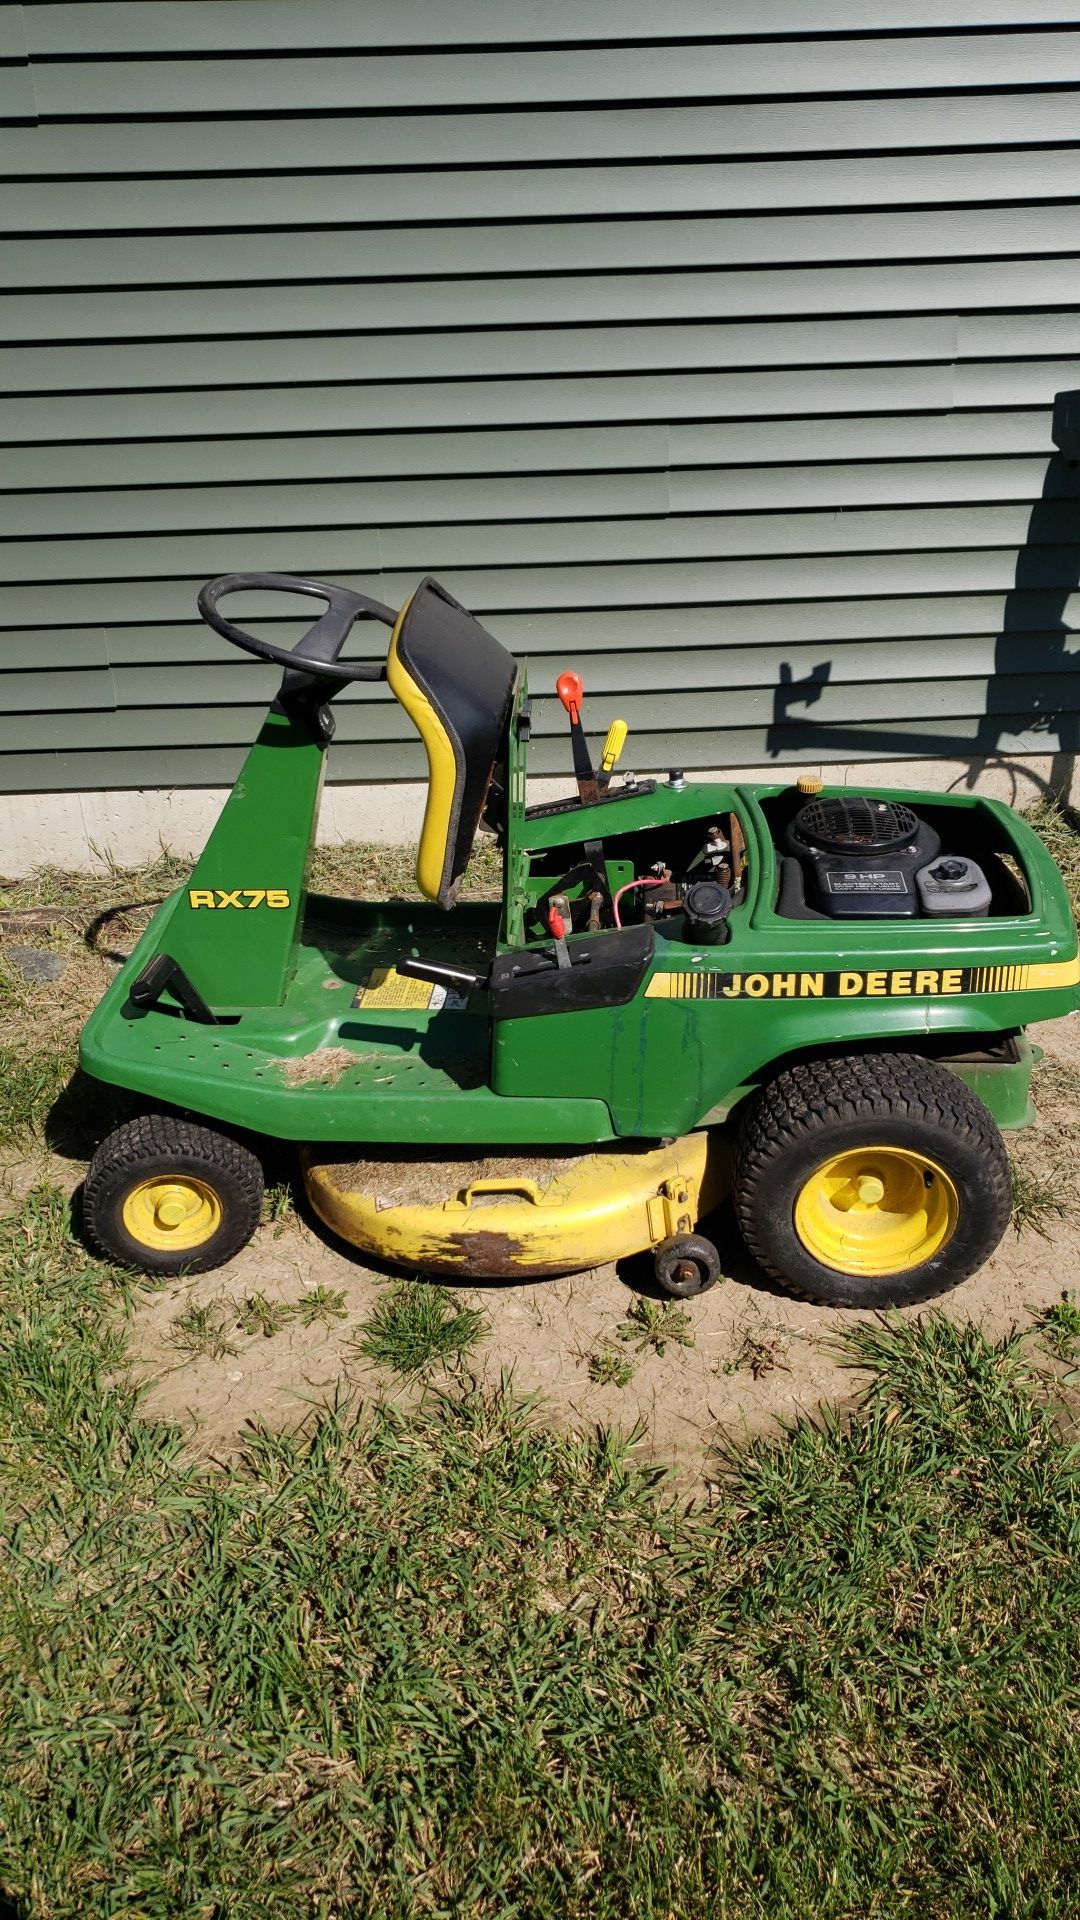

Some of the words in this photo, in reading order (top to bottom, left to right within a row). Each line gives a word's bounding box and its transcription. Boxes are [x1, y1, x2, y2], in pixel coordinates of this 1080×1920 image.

[189, 889, 290, 909] RX75
[723, 973, 824, 997] JOHN
[839, 969, 963, 996] DEERE
